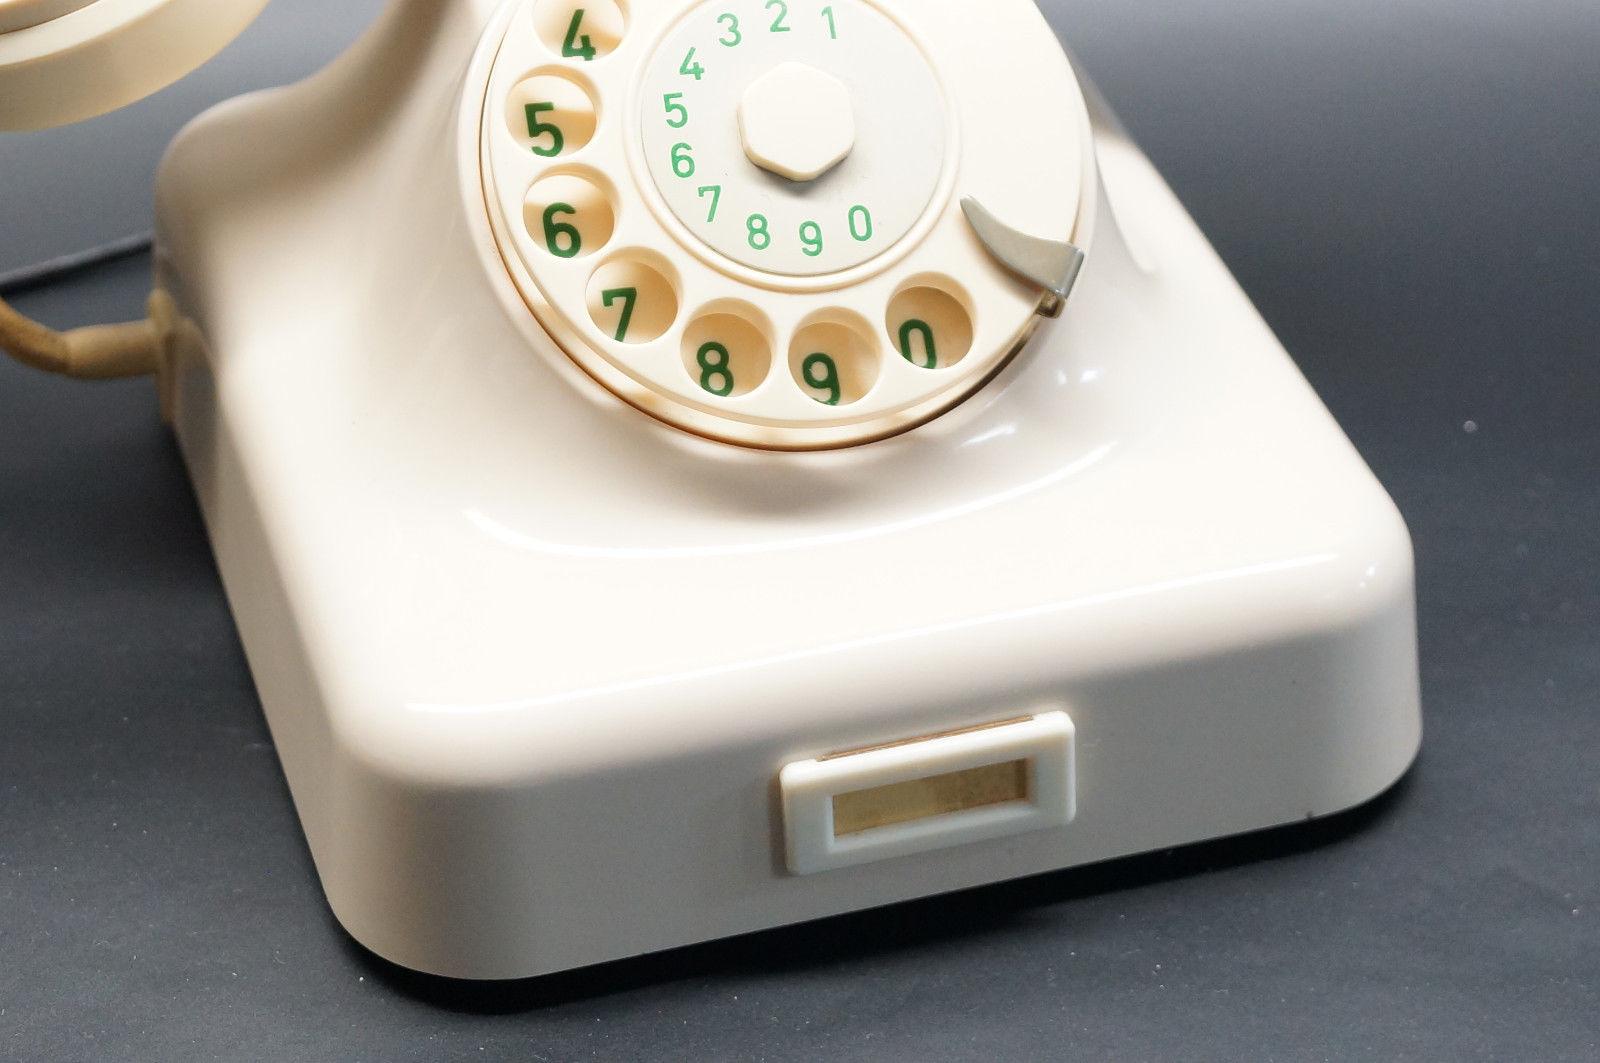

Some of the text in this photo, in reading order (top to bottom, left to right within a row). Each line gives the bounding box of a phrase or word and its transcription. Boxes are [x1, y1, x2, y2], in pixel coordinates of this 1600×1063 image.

[561, 9, 596, 61] 4
[717, 13, 742, 47] 3
[768, 0, 791, 32] 2
[821, 6, 837, 39] 1
[679, 47, 704, 80] 4
[663, 92, 688, 128] 5
[525, 102, 564, 157] 5
[670, 142, 695, 179] 6
[697, 185, 722, 223] 7
[848, 204, 873, 242] 0
[542, 203, 581, 258] 6
[746, 213, 771, 250] 8
[799, 220, 823, 257] 9
[602, 287, 637, 343] 7
[899, 319, 936, 370] 0
[696, 342, 734, 397] 8
[803, 352, 840, 405] 9
